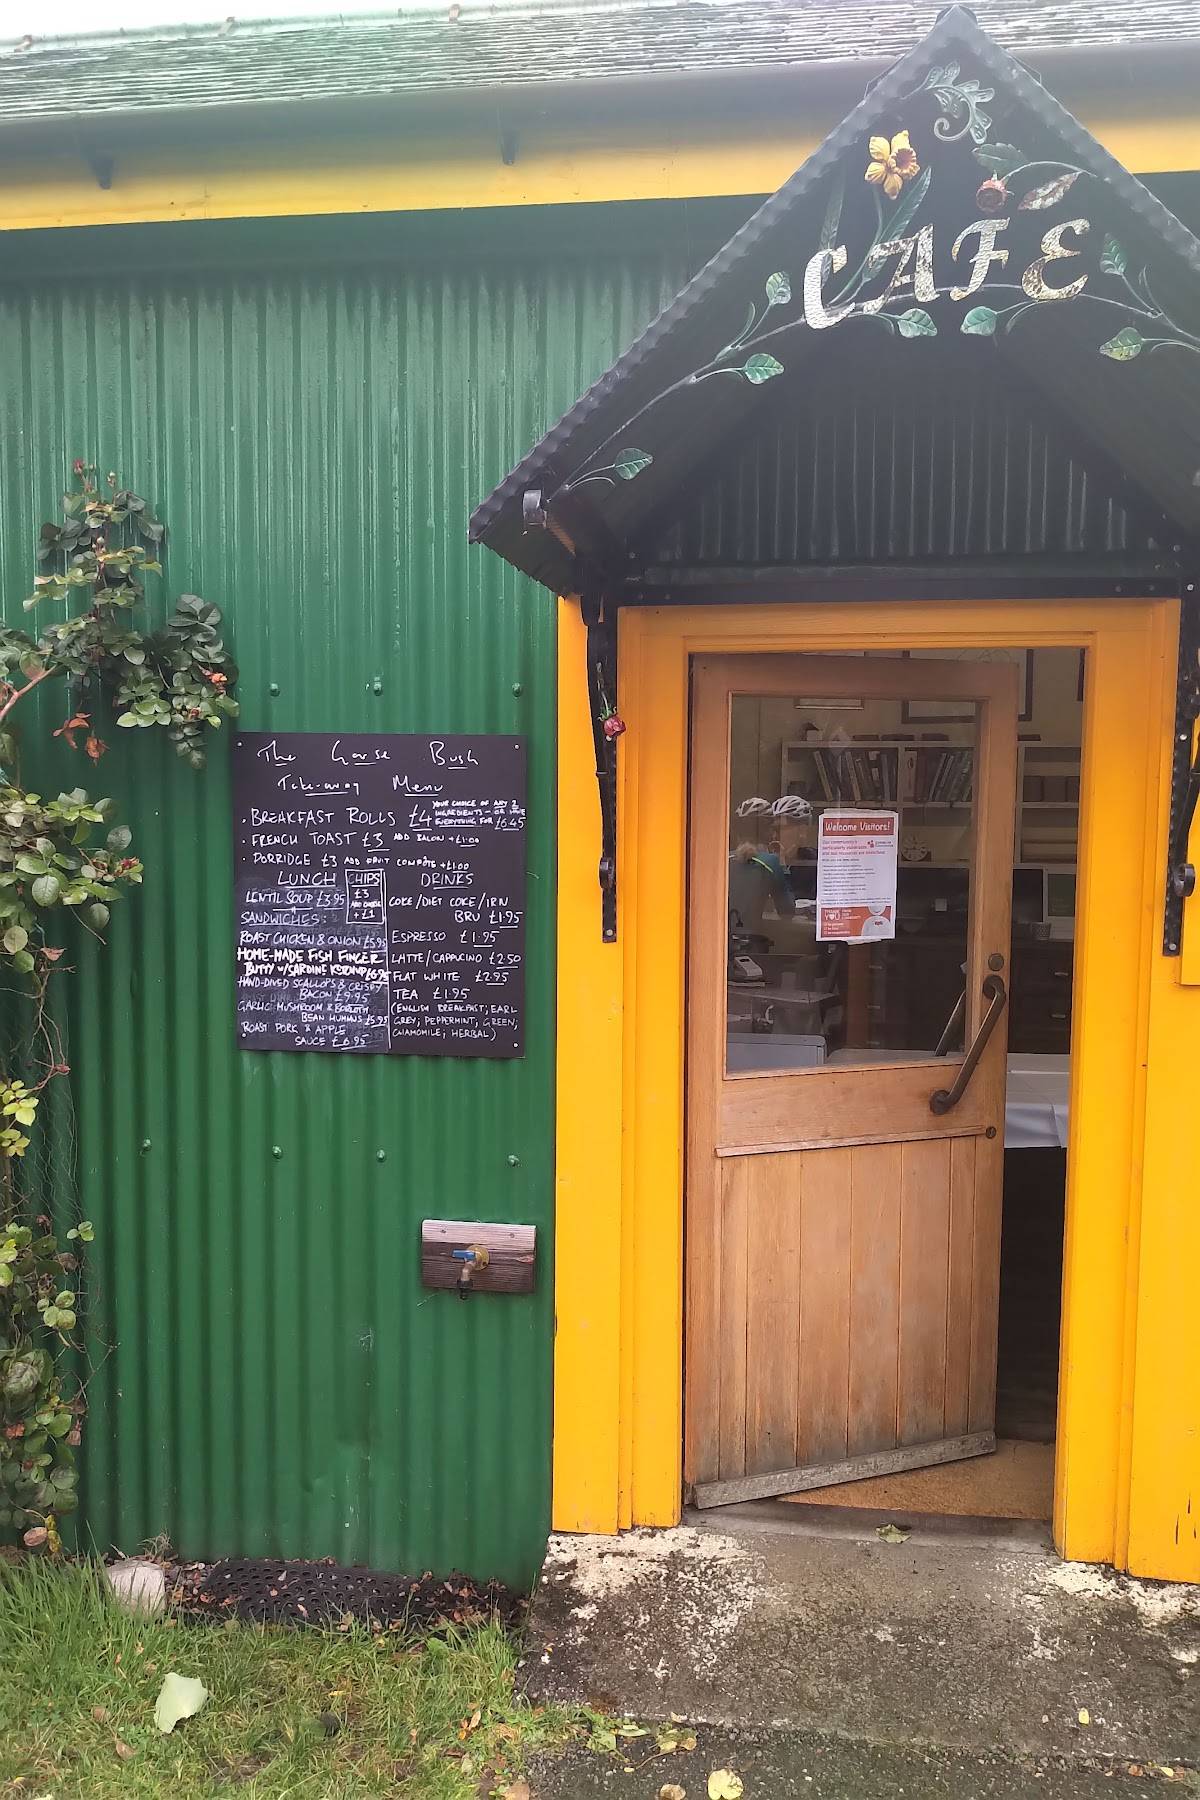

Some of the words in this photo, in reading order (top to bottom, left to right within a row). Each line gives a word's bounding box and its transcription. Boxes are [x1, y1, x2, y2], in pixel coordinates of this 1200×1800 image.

[803, 217, 1091, 330] CAFE
[257, 740, 296, 762] The
[429, 741, 479, 766] Bush
[392, 775, 443, 792] Menu
[511, 799, 519, 807] 2
[251, 808, 335, 828] BREAKFAST
[345, 807, 396, 826] ROLLS
[409, 804, 432, 827] £4
[434, 809, 483, 817] INGREDIENTS
[434, 817, 477, 825] EVERYTHING
[825, 821, 858, 832] Welcome
[860, 821, 891, 831] Visitors!
[251, 833, 298, 847] FRENCH
[308, 831, 358, 846] TOAST
[361, 832, 384, 848] £3
[393, 832, 410, 841] ADD
[252, 852, 311, 866] PORRIDGE
[321, 853, 338, 867] £3
[344, 856, 361, 866] ADD
[366, 856, 390, 865] FRUIT
[277, 870, 337, 886] LUNCH
[348, 872, 380, 885] CHIPS
[421, 873, 474, 887] DRINKS
[245, 891, 284, 904] LENTIL
[285, 890, 314, 904] SOUP
[316, 891, 347, 908] £3.95
[354, 888, 370, 899] £3
[350, 900, 362, 908] ADD
[361, 909, 376, 920] £1
[454, 910, 481, 923] BRU
[489, 910, 523, 924] £1.95
[239, 930, 272, 946] ROAST
[272, 932, 315, 946] CHICKEN
[316, 934, 325, 946] &
[327, 936, 361, 946] ONION
[391, 930, 447, 943] ESPRESSO
[237, 948, 304, 964] HOME-MADE
[308, 949, 332, 963] FISH
[338, 950, 384, 964] FINGER
[489, 951, 521, 965] £2.50
[244, 962, 275, 976] BUTTY
[392, 971, 418, 982] FLAT
[423, 971, 461, 981] WHITE
[475, 970, 509, 982] £2.95
[237, 976, 290, 990] HAND-DIVED
[293, 978, 336, 989] SCALLOPS
[337, 979, 346, 990] &
[348, 982, 383, 993] CRISPY
[299, 989, 333, 1001] BACON
[392, 988, 419, 1000] TEA
[433, 987, 471, 1000] £1.95
[237, 1001, 270, 1012] GARLIC
[276, 1002, 323, 1012] MUSHROOM
[491, 1004, 518, 1014] EARL
[301, 1012, 325, 1023] BEAN
[241, 1021, 268, 1034] ROAST
[275, 1023, 299, 1034] PORK
[305, 1024, 311, 1032] &
[315, 1024, 346, 1035] APPLE
[294, 1036, 326, 1046] SAUCE
